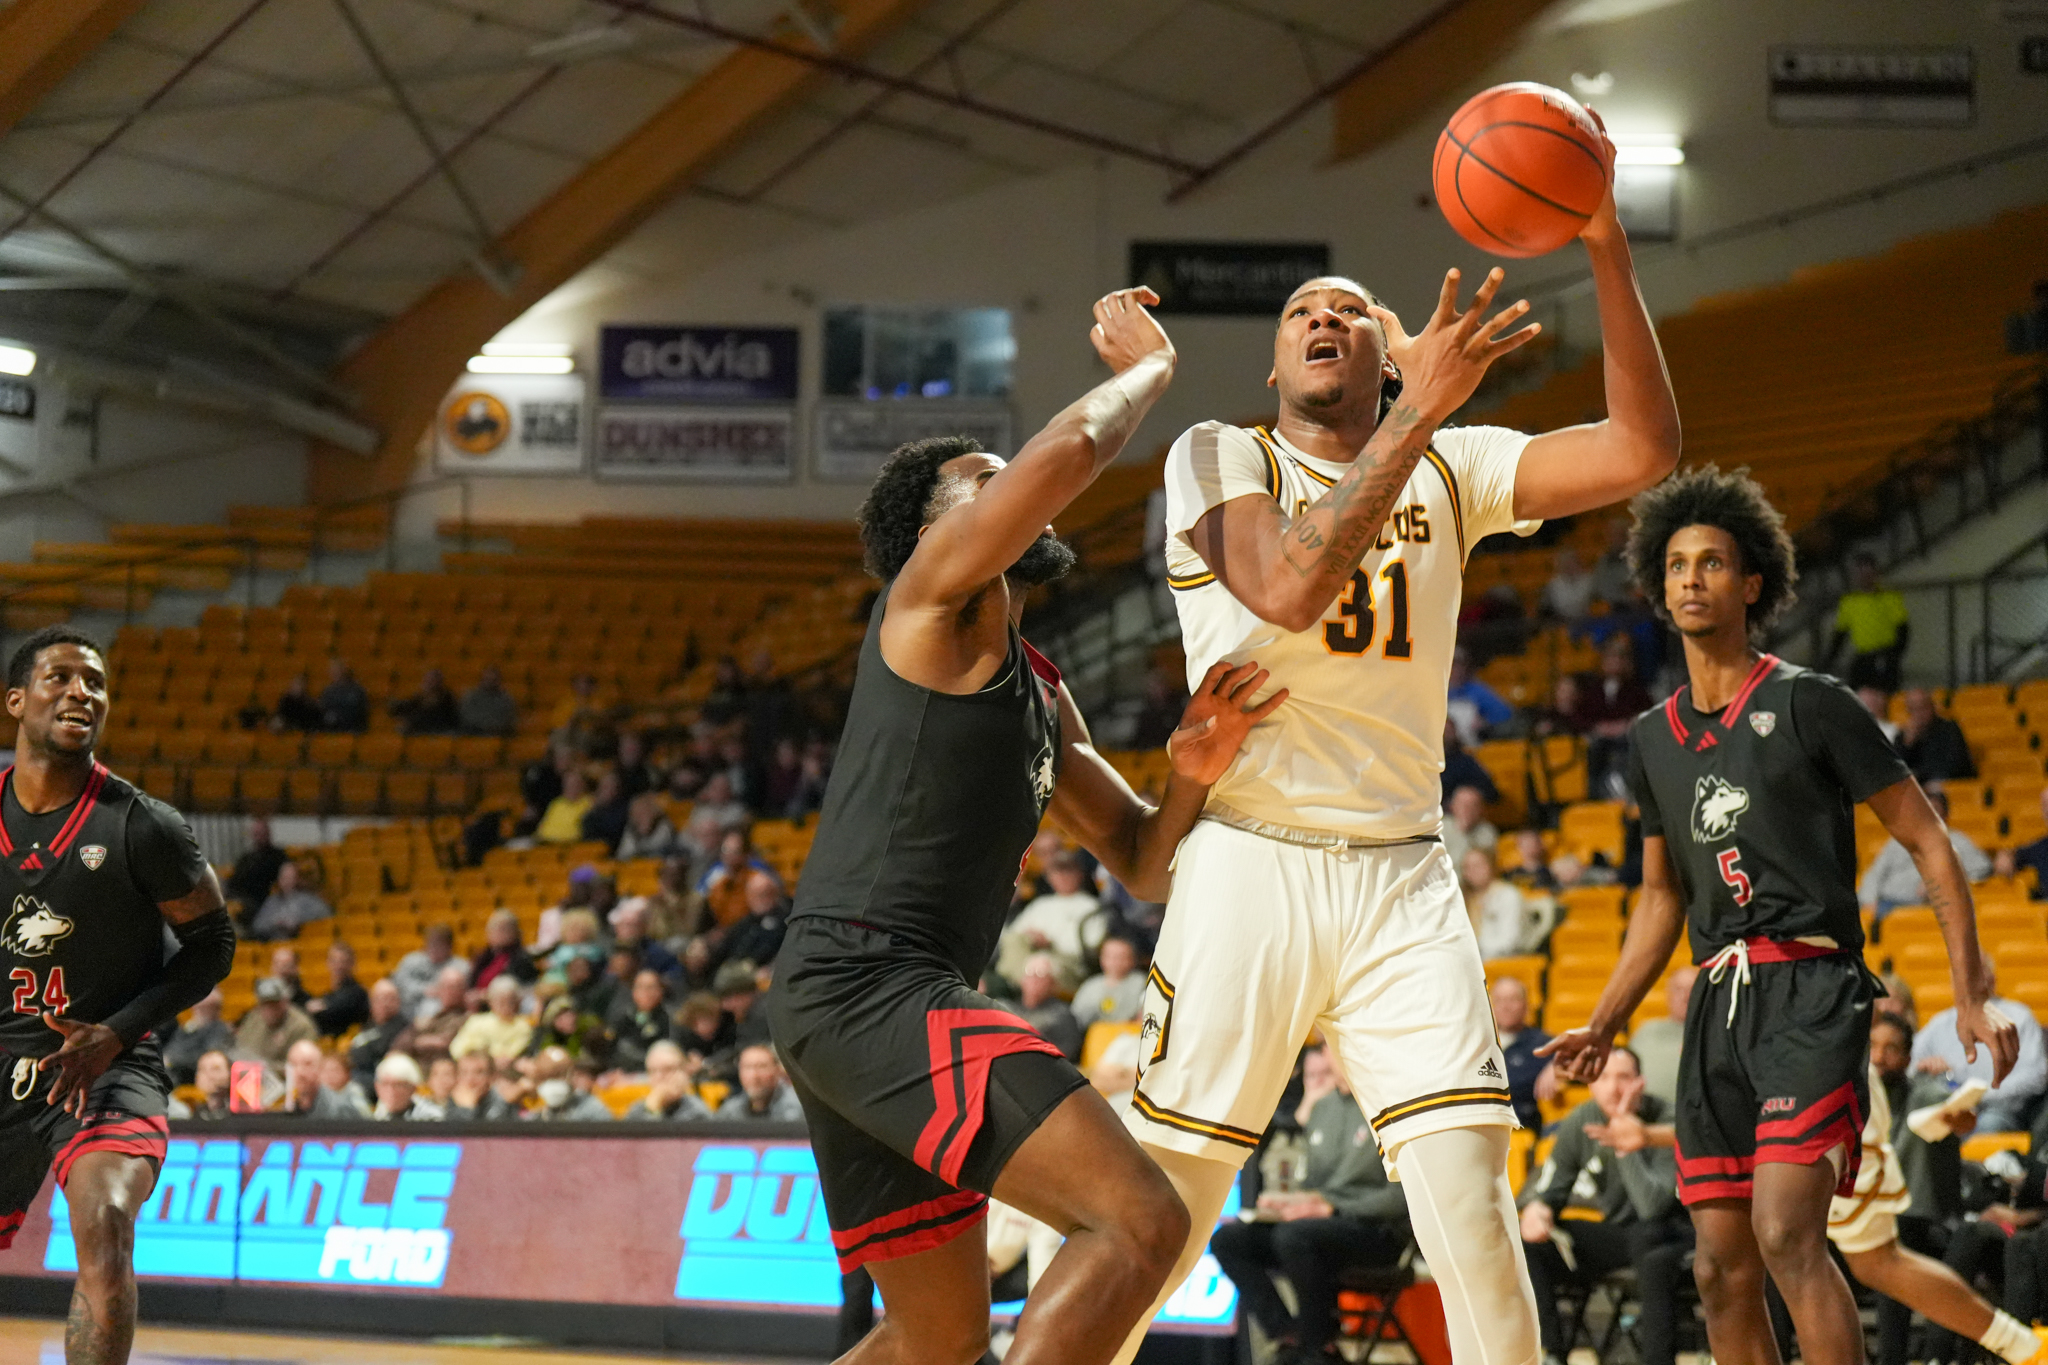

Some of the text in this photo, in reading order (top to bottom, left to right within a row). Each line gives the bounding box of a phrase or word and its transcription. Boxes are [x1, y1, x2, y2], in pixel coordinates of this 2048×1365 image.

[1321, 558, 1414, 661] 31
[1716, 846, 1753, 908] 5
[9, 966, 70, 1017] 24
[1477, 1069, 1503, 1080] adidas
[1761, 1096, 1797, 1116] NIU
